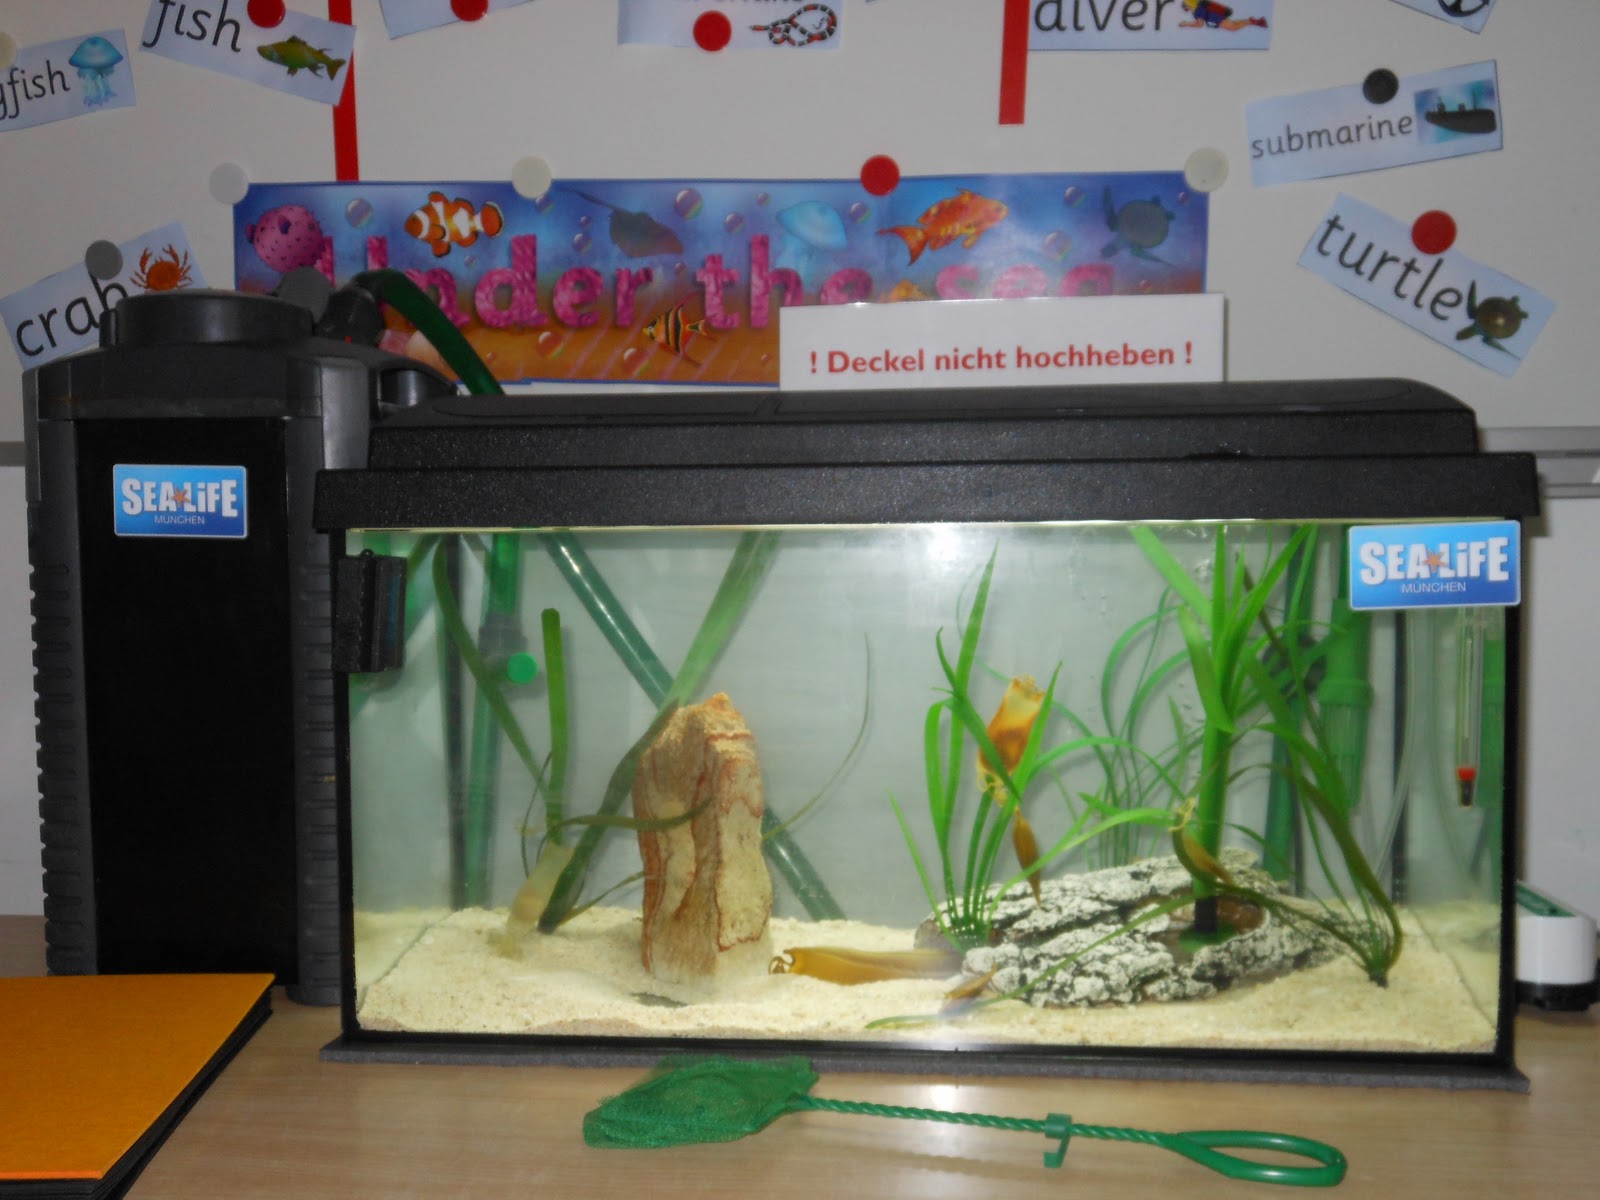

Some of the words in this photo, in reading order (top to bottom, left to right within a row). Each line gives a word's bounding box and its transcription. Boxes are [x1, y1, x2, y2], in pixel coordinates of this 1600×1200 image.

[1251, 113, 1413, 159] submarine
[1315, 214, 1463, 321] turtle
[828, 349, 925, 374] Deckel
[934, 347, 1007, 371] nicht
[1016, 342, 1175, 370] hochheben
